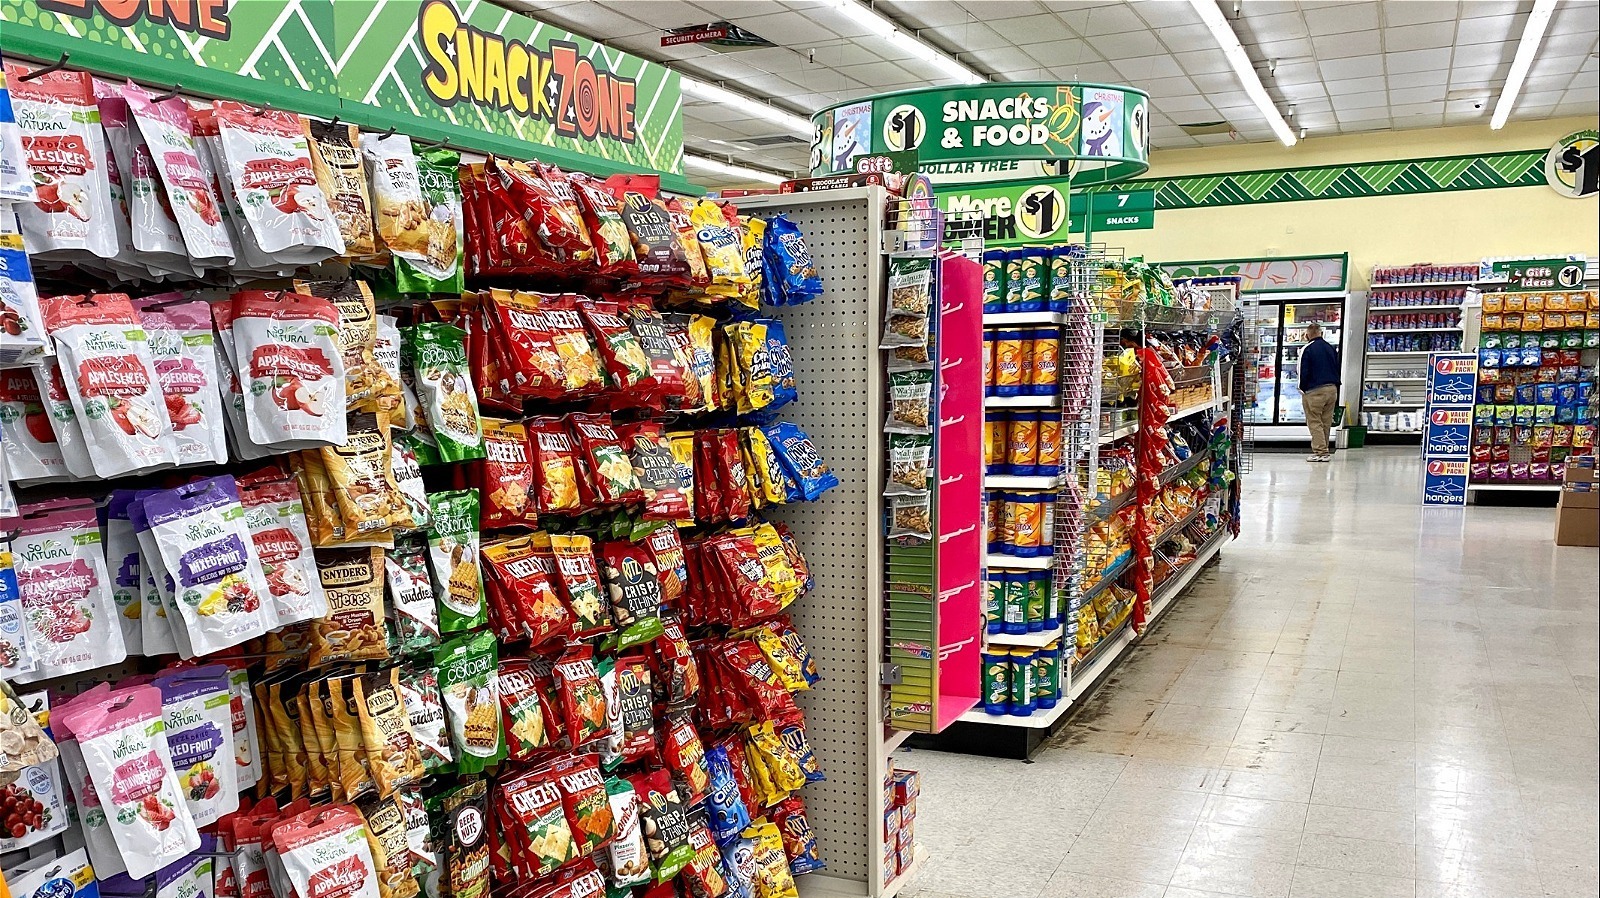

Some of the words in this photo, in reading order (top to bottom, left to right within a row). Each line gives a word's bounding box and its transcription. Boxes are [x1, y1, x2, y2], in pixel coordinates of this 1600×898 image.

[666, 35, 693, 44] SECURITY
[696, 30, 722, 41] CAMERA
[421, 3, 553, 118] SNACK
[552, 46, 635, 141] ZONE
[1094, 92, 1123, 103] CHRISTMAS
[842, 105, 871, 117] CHRISTMAS
[943, 97, 1048, 122] SNACKS
[17, 121, 66, 131] NATURAL
[891, 109, 916, 150] $1
[941, 128, 964, 148] &
[973, 124, 1050, 147] FOOD
[857, 157, 893, 173] Gift
[919, 162, 974, 174] DOLLAR
[981, 161, 1019, 172] TREE
[812, 178, 849, 186] CHOCOLATE
[948, 195, 1012, 221] More
[1118, 195, 1130, 207] 7
[1023, 190, 1055, 235] $1
[943, 214, 1017, 240] OWER
[1106, 216, 1140, 225] SNACKS
[1526, 268, 1552, 277] Gift
[1563, 269, 1578, 286] $1
[1521, 278, 1554, 287] Ideas
[635, 323, 664, 337] CRISP
[85, 340, 126, 350] NATURAL
[1441, 359, 1449, 371] 7
[1434, 392, 1472, 402] hangers
[1436, 411, 1445, 421] 7
[1429, 443, 1467, 453] hangers
[642, 456, 670, 468] CRISP
[1432, 462, 1441, 471] 7
[1425, 493, 1463, 503] hangers
[186, 526, 225, 541] NATURAL
[28, 544, 41, 552] So
[20, 550, 72, 562] NATURAL
[323, 566, 368, 580] SNYDER'S
[622, 563, 642, 581] RITZ
[400, 585, 433, 605] buddies
[625, 583, 657, 597] CRISP
[327, 590, 372, 609] Pieces
[621, 673, 640, 694] RITZ
[622, 694, 648, 711] CRISP
[165, 714, 203, 730] NATURAL
[171, 711, 181, 721] So
[113, 741, 147, 759] NATURAL
[170, 744, 188, 757] XED
[190, 738, 213, 754] FRUIT
[459, 813, 475, 828] BEER
[657, 811, 680, 829] CRISP
[461, 822, 477, 840] NUTS
